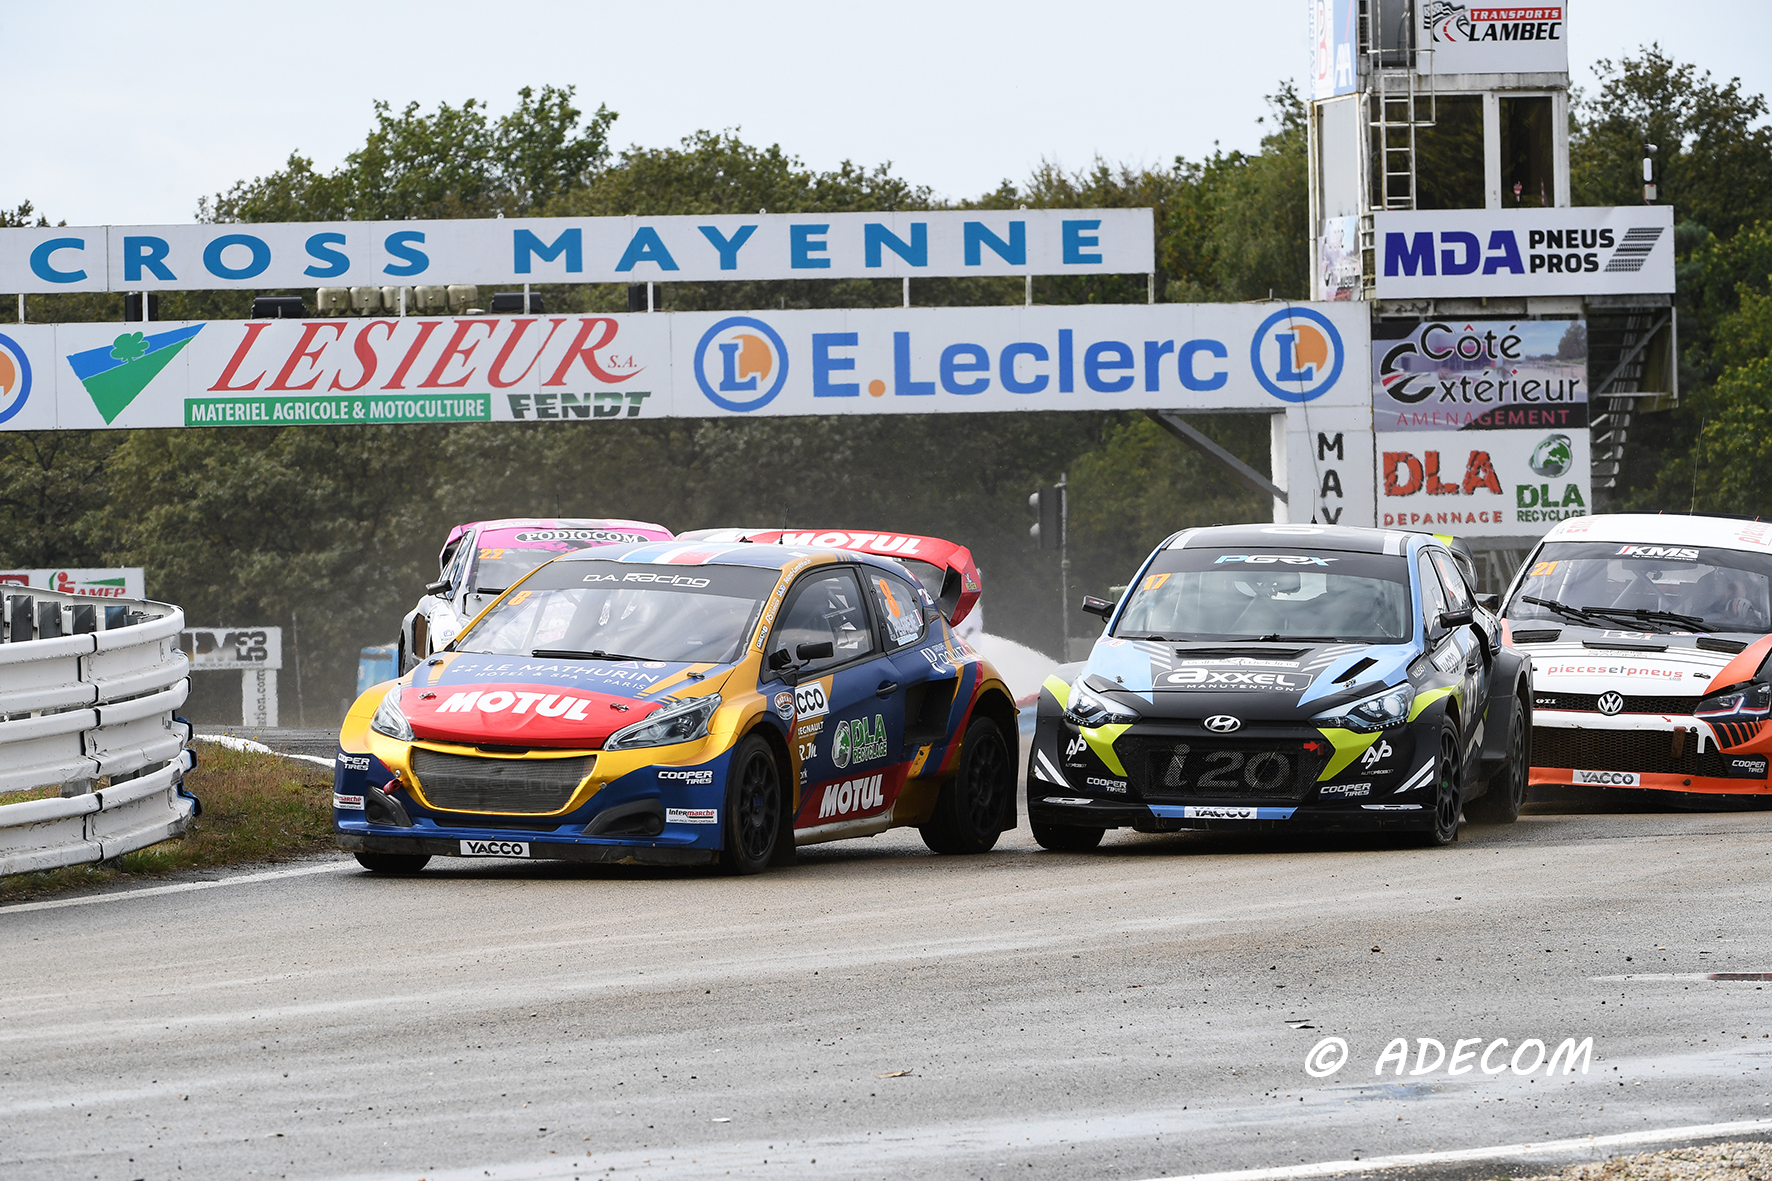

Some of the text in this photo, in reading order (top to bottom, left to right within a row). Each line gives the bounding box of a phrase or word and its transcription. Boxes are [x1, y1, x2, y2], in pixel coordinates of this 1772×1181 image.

[1471, 8, 1560, 20] TRANSPORTS
[1469, 22, 1562, 41] LAMBEC
[1529, 228, 1614, 249] PNEUS
[29, 219, 1102, 284] CROSS MAYENNE
[1384, 230, 1525, 276] MDA
[1529, 253, 1599, 273] PROS
[1421, 323, 1522, 360] Côté
[207, 317, 647, 392] LESIEUR S.A.
[812, 328, 1228, 397] E.Leclerc
[192, 399, 485, 422] MATERIEL AGRICOLE & MOTOCULTURE
[507, 391, 652, 420] FENDT
[1382, 450, 1503, 496] DLA
[1516, 483, 1585, 508] DLA
[1383, 511, 1503, 526] DEPANNAGE
[1517, 509, 1586, 522] RECYCLAGE
[525, 530, 639, 543] PODIOCOM
[771, 531, 922, 555] MOTUL
[478, 548, 505, 560] 22
[1530, 561, 1559, 577] 21
[1143, 573, 1172, 591] 17
[508, 590, 532, 606] 8
[879, 579, 901, 618] 8
[483, 663, 659, 683] LE MATHURIN
[1547, 664, 1683, 678] piecesetpneus
[603, 678, 646, 689] PARIS
[1186, 684, 1294, 692] MANUTENTION
[435, 691, 592, 721] MOTUL
[851, 714, 887, 747] DLA
[852, 741, 888, 764] RECYCLAGE
[1164, 743, 1290, 789] i20
[1731, 759, 1766, 769] COOPER
[658, 770, 713, 779] COOPER
[1086, 777, 1127, 788] COOPER
[1579, 771, 1634, 785] YACCO
[818, 774, 884, 819] MOTUL
[1320, 782, 1372, 794] COOPER
[1193, 806, 1251, 818] YACCO
[467, 841, 523, 855] YACCO
